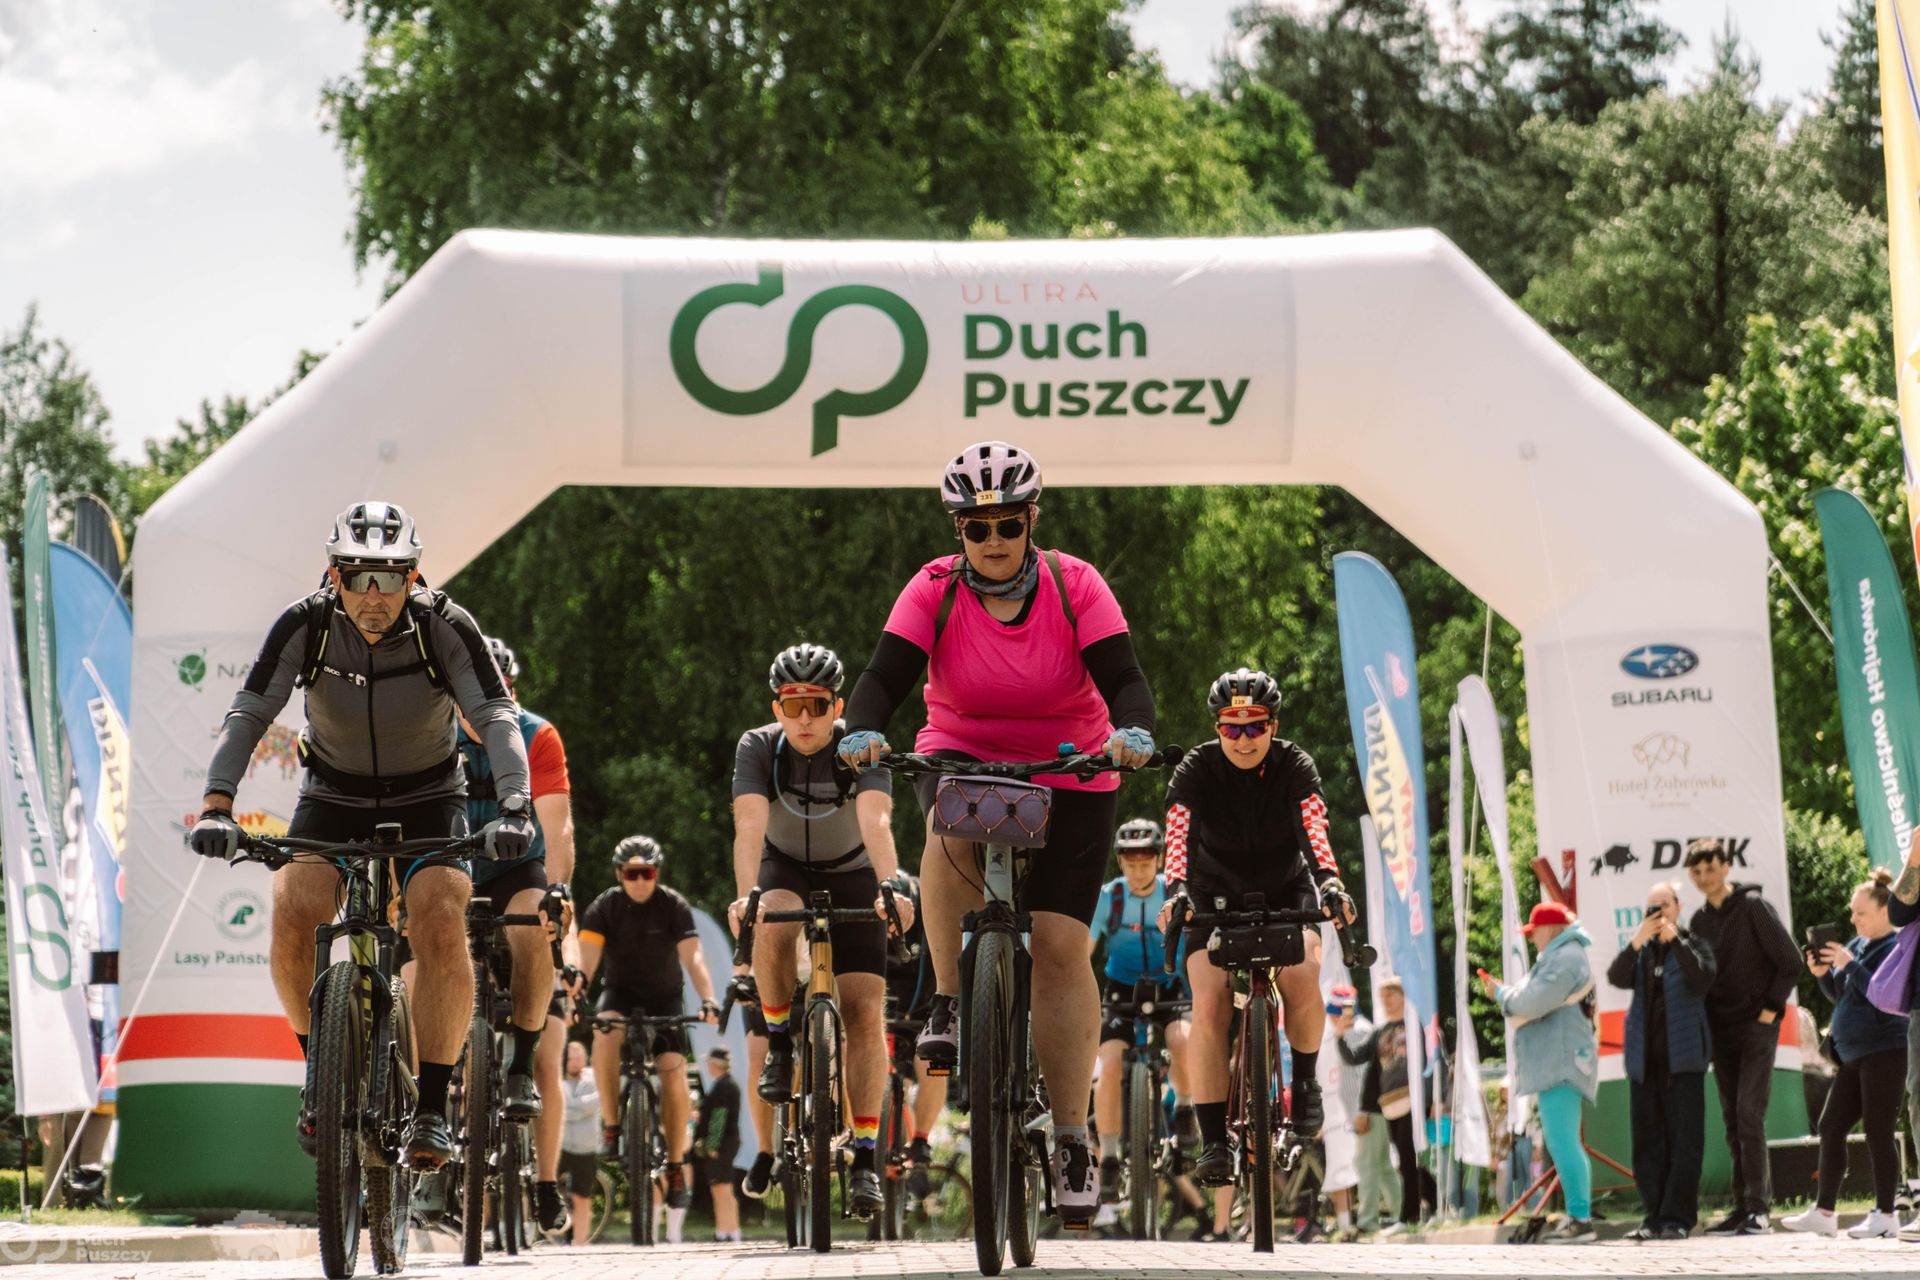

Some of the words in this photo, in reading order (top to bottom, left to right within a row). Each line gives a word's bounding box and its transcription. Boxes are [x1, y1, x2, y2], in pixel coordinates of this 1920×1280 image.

[961, 282, 1099, 304] ULTRA
[963, 309, 1148, 360] Duch
[963, 371, 1251, 426] Puszczy
[1611, 687, 1712, 707] SUBARU
[1608, 776, 1648, 795] Hotel
[1650, 837, 1751, 870] DK
[175, 950, 210, 968] Lasy
